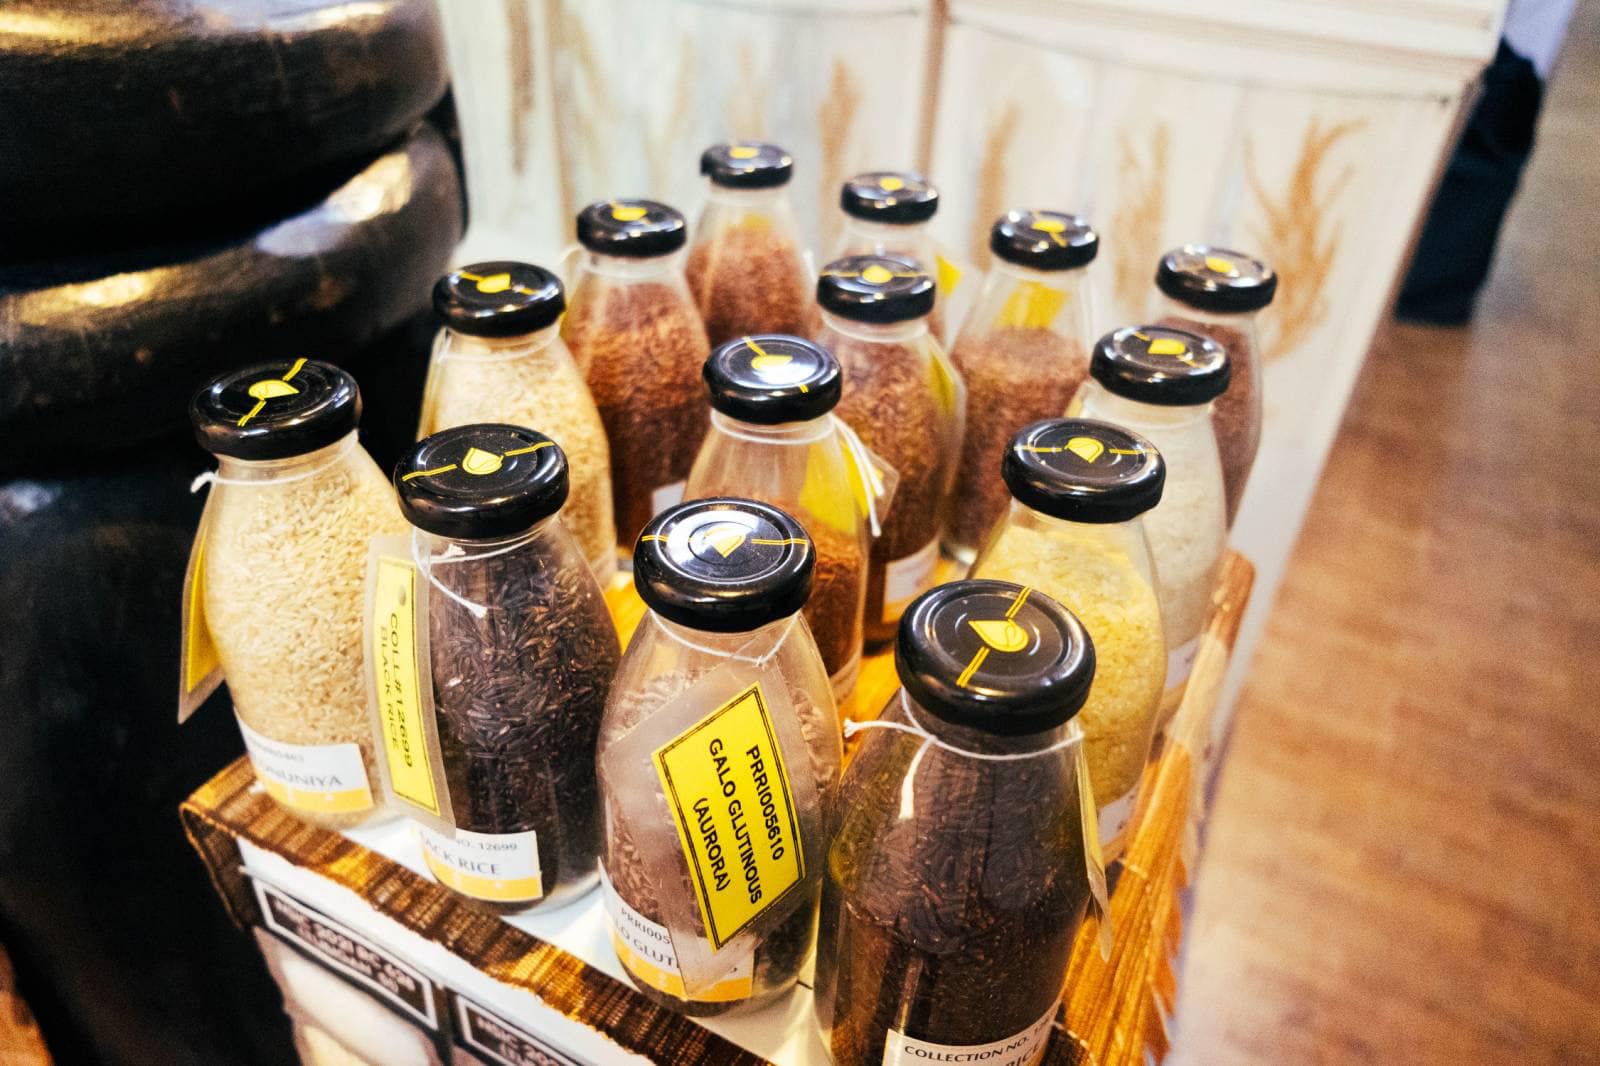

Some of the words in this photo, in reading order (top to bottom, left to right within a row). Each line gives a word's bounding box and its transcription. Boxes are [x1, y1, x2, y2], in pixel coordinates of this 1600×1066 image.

[379, 626, 391, 695] BLACK
[386, 703, 399, 750] RICE
[693, 797, 731, 892] (AURORA)
[709, 738, 737, 798] GALO
[728, 799, 763, 904] GLUTINOUS
[746, 744, 785, 861] PRRI005610
[458, 858, 501, 875] RICE
[621, 906, 671, 945] PRRI005
[904, 1044, 1004, 1063] COLLECTION
[1006, 1036, 1030, 1052] NO.
